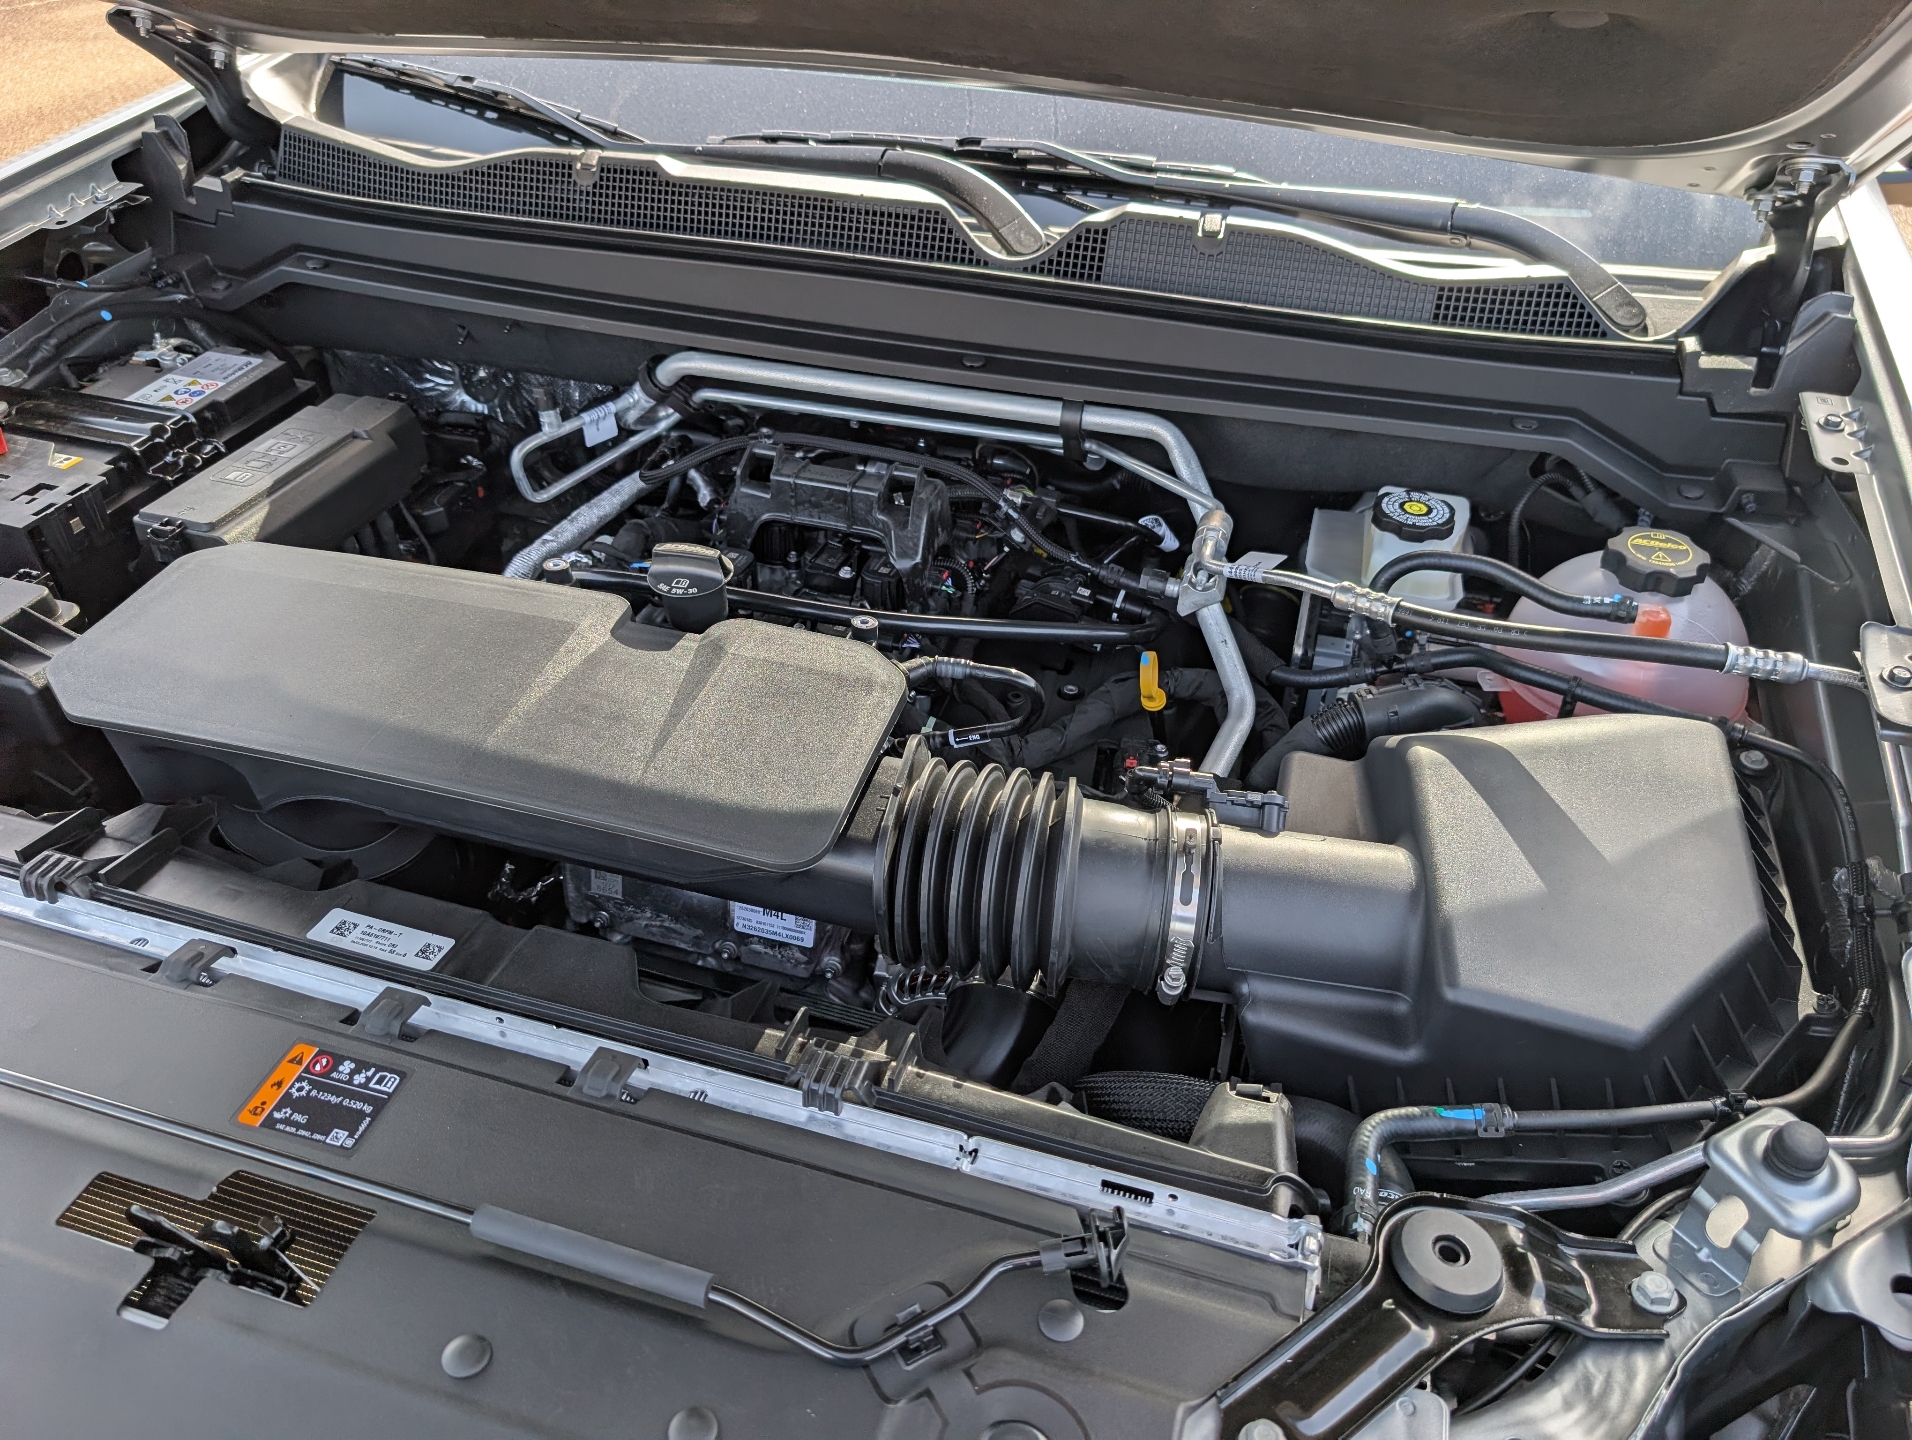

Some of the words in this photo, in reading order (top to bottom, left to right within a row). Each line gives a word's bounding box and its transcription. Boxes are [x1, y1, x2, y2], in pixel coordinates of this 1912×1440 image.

[1630, 539, 1687, 550] ACDelco
[657, 583, 671, 592] SAE
[671, 587, 698, 595] 5W-30
[762, 907, 787, 921] M4L
[330, 1071, 350, 1081] AUTO
[309, 1089, 343, 1104] R-1234yf
[343, 1098, 364, 1110] 0.520
[362, 1102, 374, 1114] kg
[291, 1112, 309, 1124] PAG
[1353, 1186, 1372, 1200] RAD
